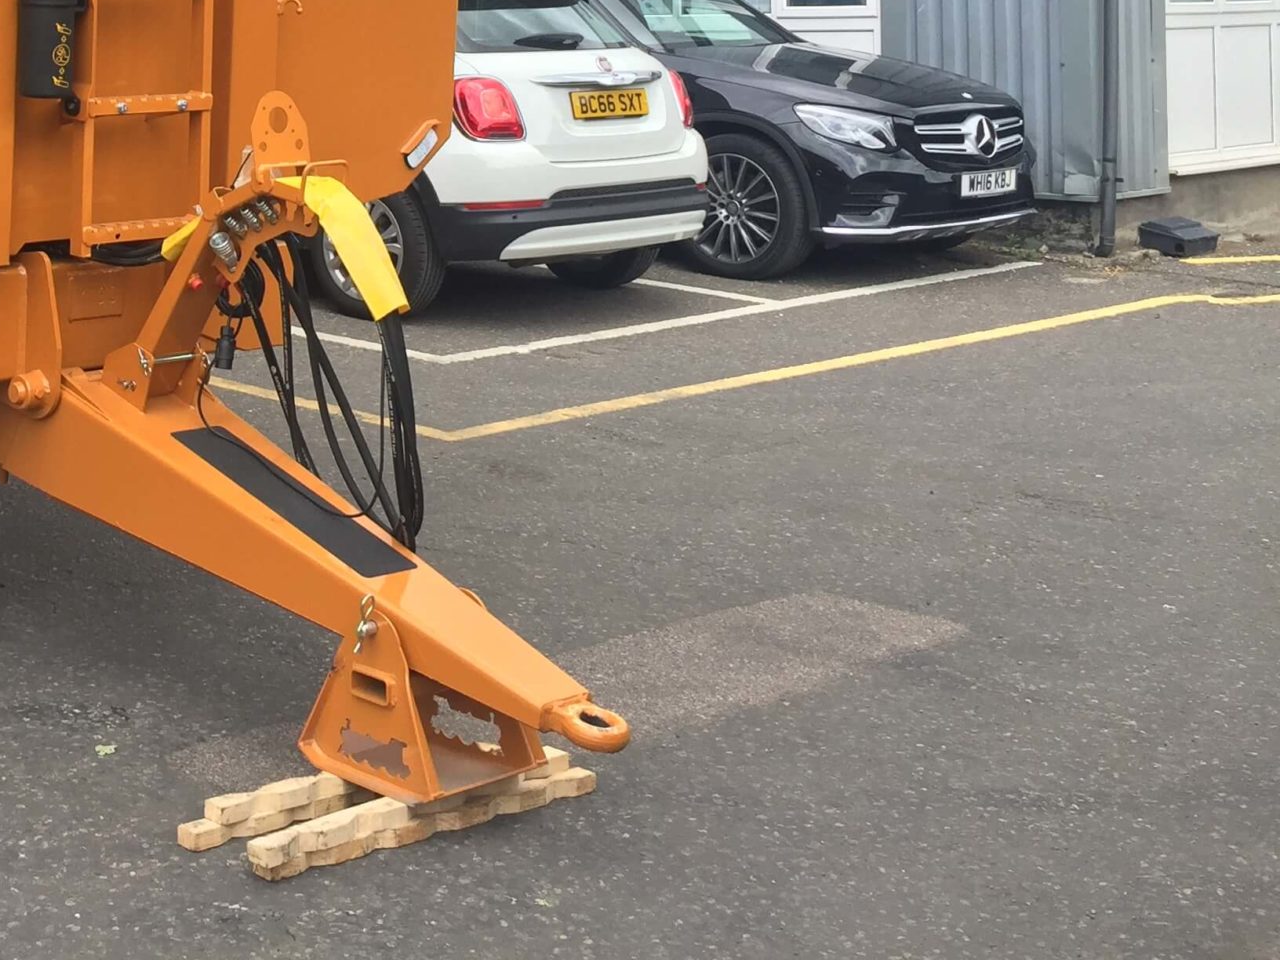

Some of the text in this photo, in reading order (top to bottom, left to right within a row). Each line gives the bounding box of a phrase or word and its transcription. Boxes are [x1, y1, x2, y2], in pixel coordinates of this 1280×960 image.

[579, 93, 643, 114] BC66 SXT
[969, 170, 1011, 192] WH16 KBJ
